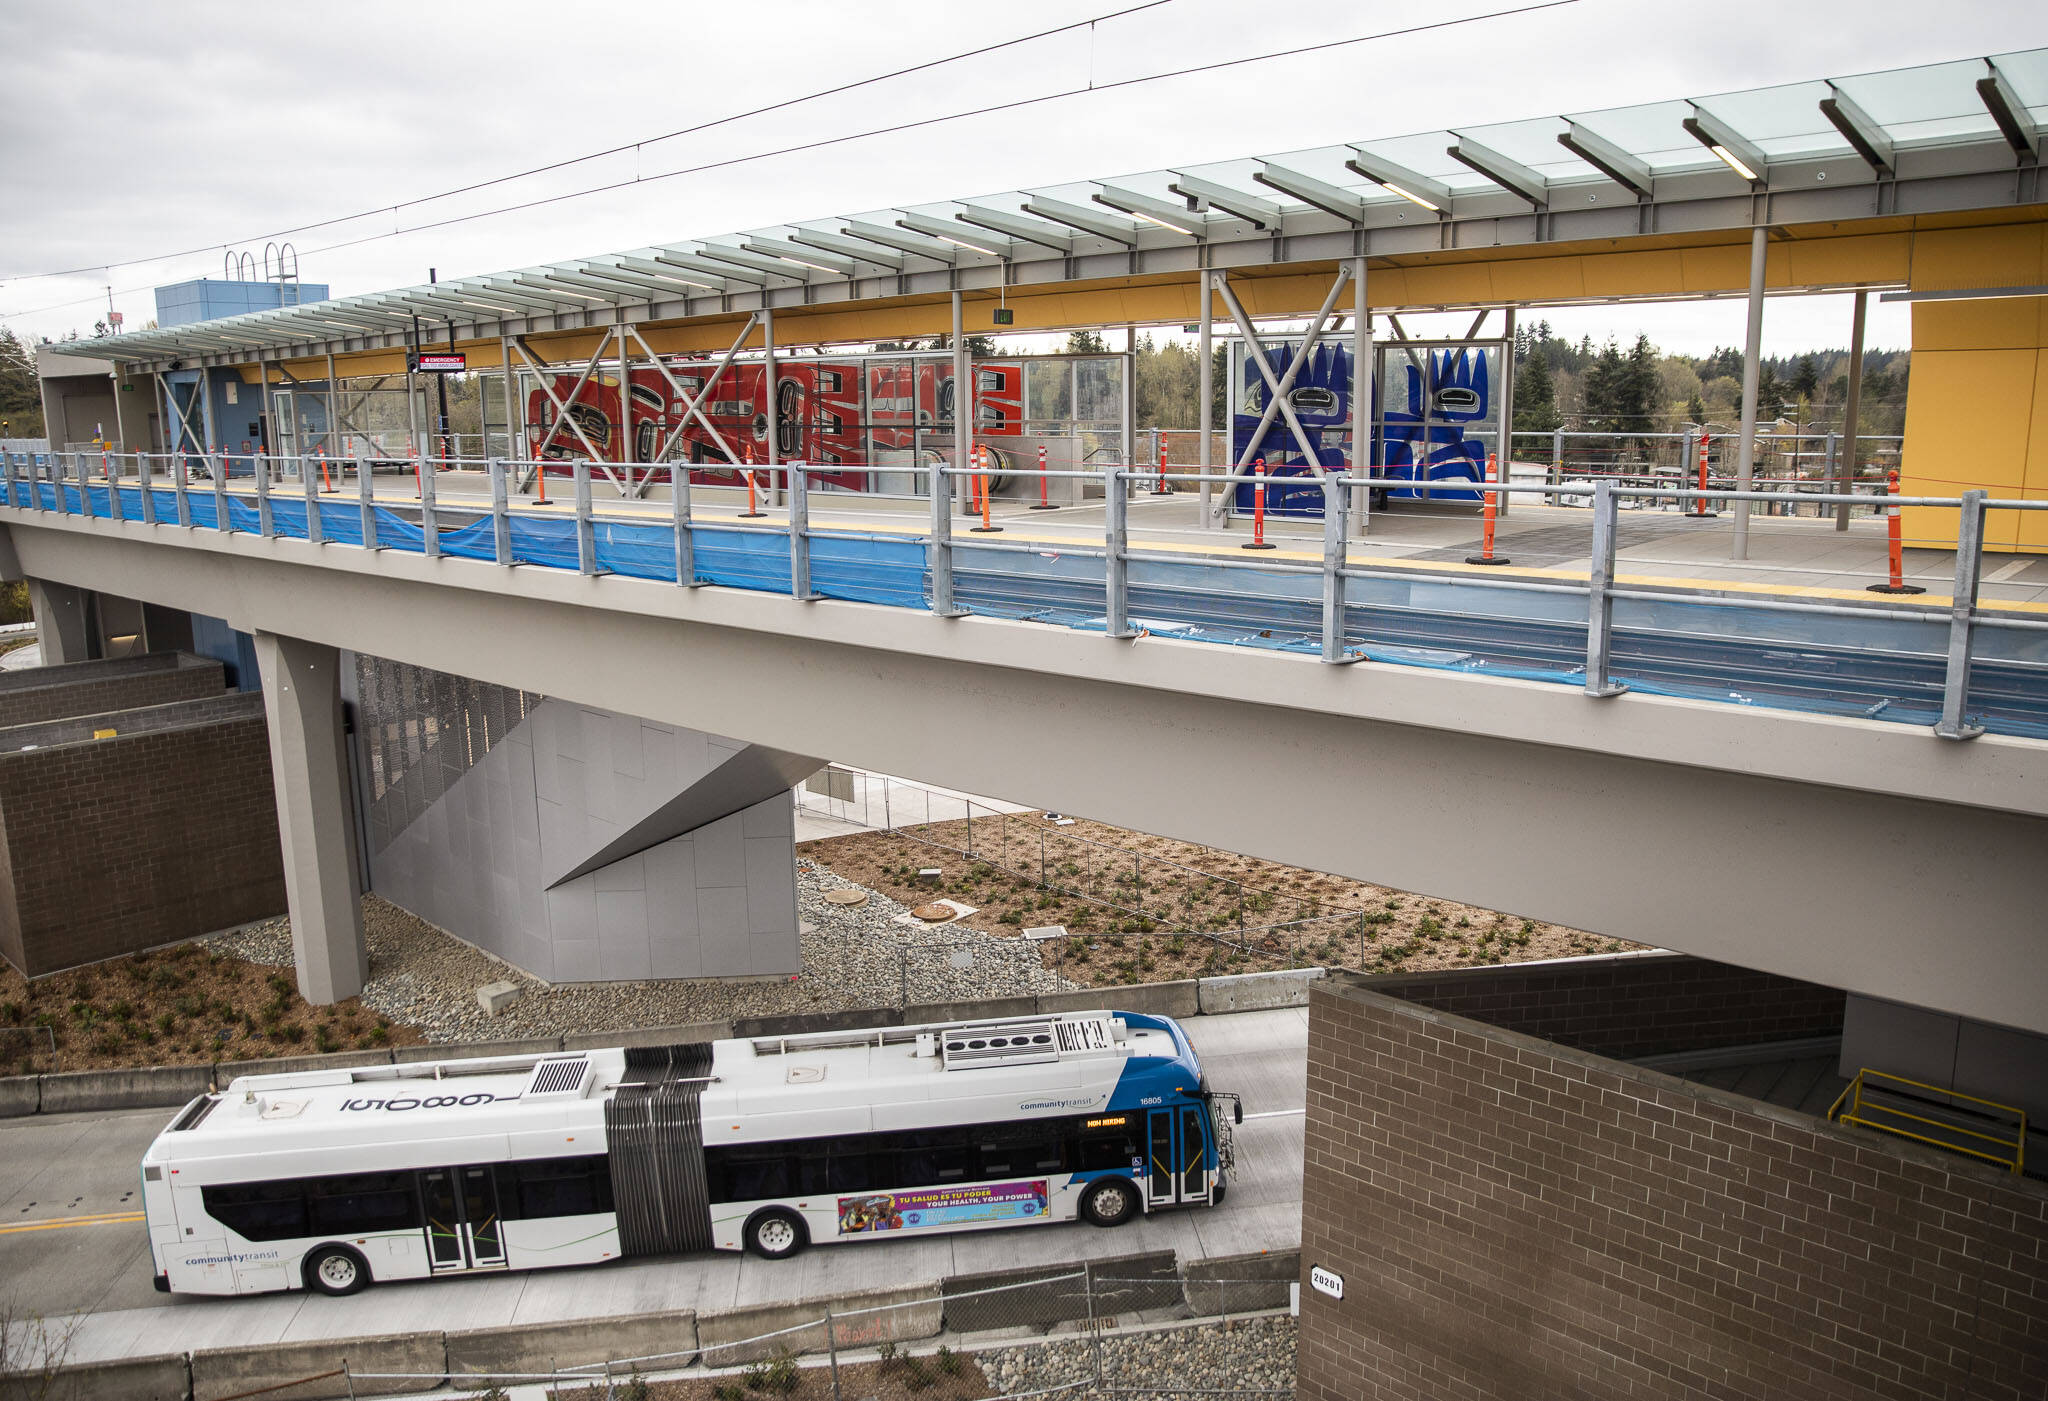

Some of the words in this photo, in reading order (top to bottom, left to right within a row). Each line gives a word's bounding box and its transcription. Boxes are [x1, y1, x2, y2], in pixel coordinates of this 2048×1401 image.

[1140, 1096, 1162, 1105] 16805
[1102, 1117, 1126, 1126] HIRING
[912, 1195, 939, 1203] SALUD
[964, 1190, 992, 1198] PODER
[950, 1197, 981, 1206] HEALTH,
[983, 1195, 1004, 1203] YOUR
[1006, 1193, 1033, 1201] POWER
[1314, 1273, 1340, 1292] 20201
